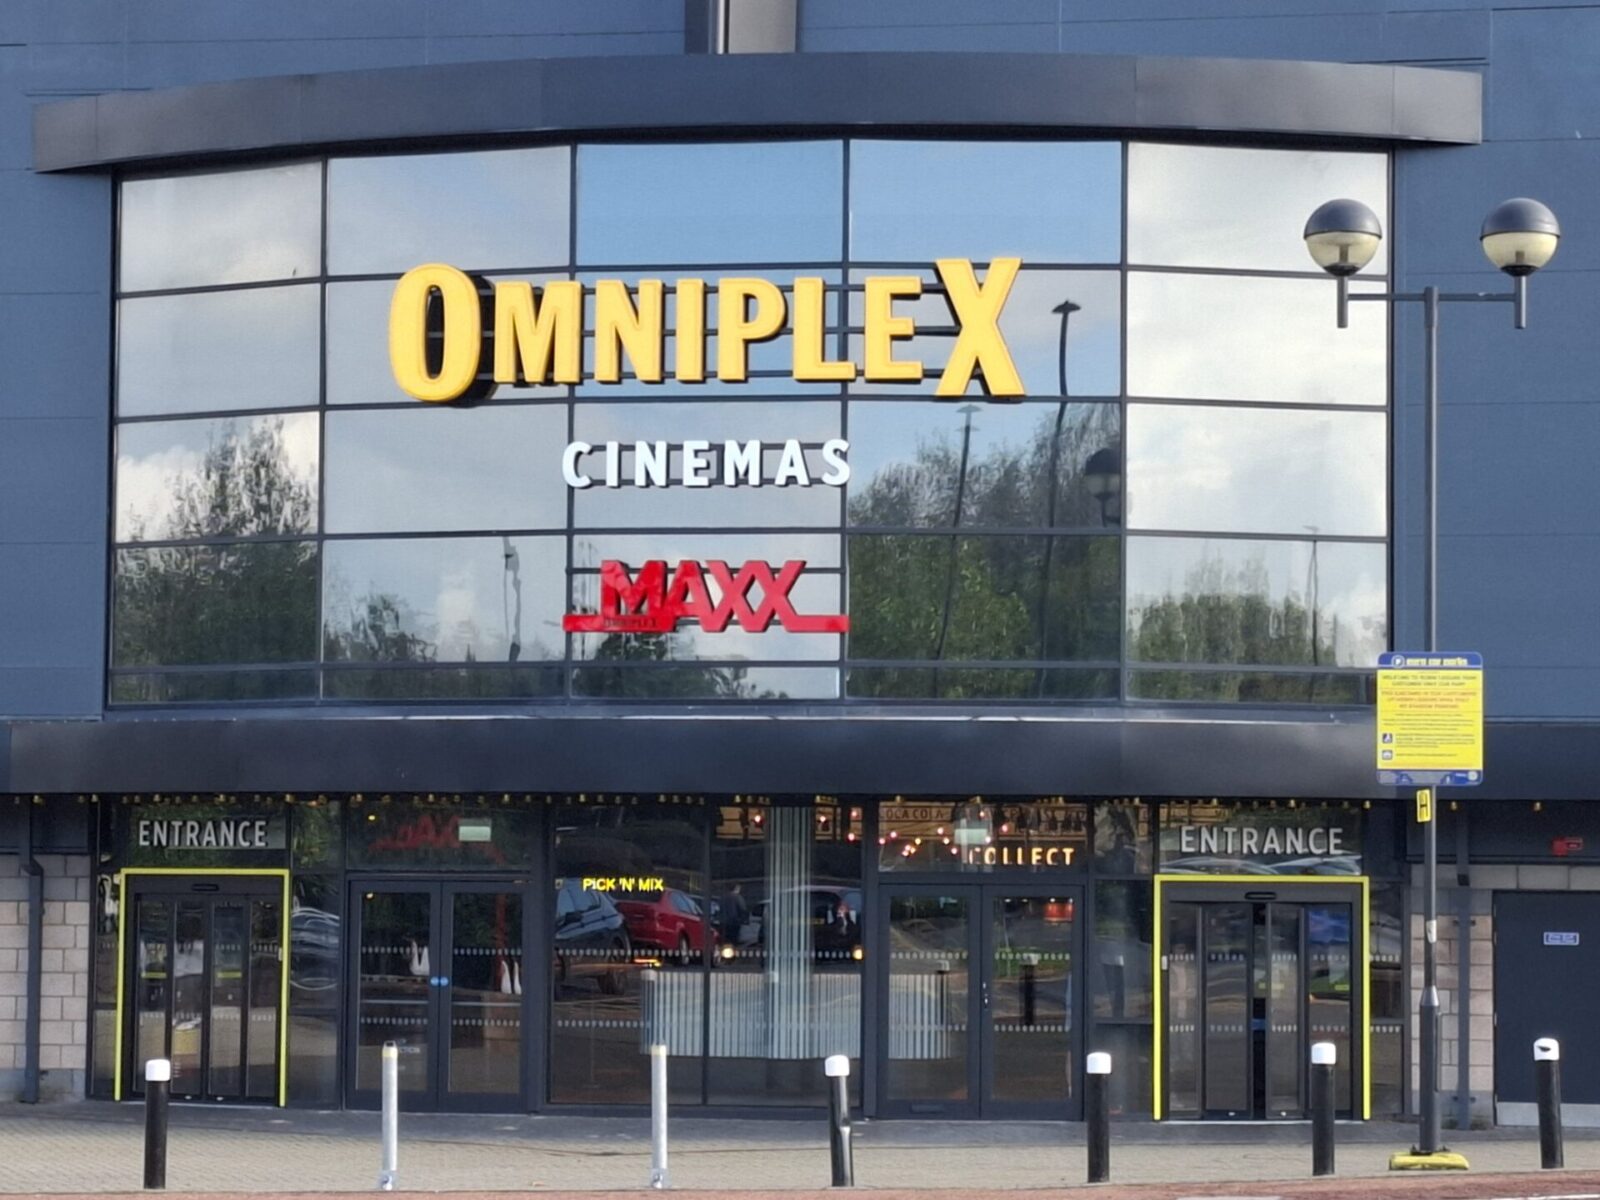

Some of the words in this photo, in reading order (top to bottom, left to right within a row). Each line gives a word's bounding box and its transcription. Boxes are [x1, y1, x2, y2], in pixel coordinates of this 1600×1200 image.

[388, 256, 1026, 404] OMNIPLEX
[562, 438, 852, 488] CINEMAS
[599, 559, 810, 633] MAXX
[879, 807, 910, 821] OCA
[138, 819, 268, 848] ENTRANCE
[1180, 825, 1344, 856] ENTRANCE
[968, 846, 1076, 866] COLLECT
[582, 877, 616, 893] PICK
[619, 877, 636, 893] 'N'
[638, 877, 665, 893] MIX
